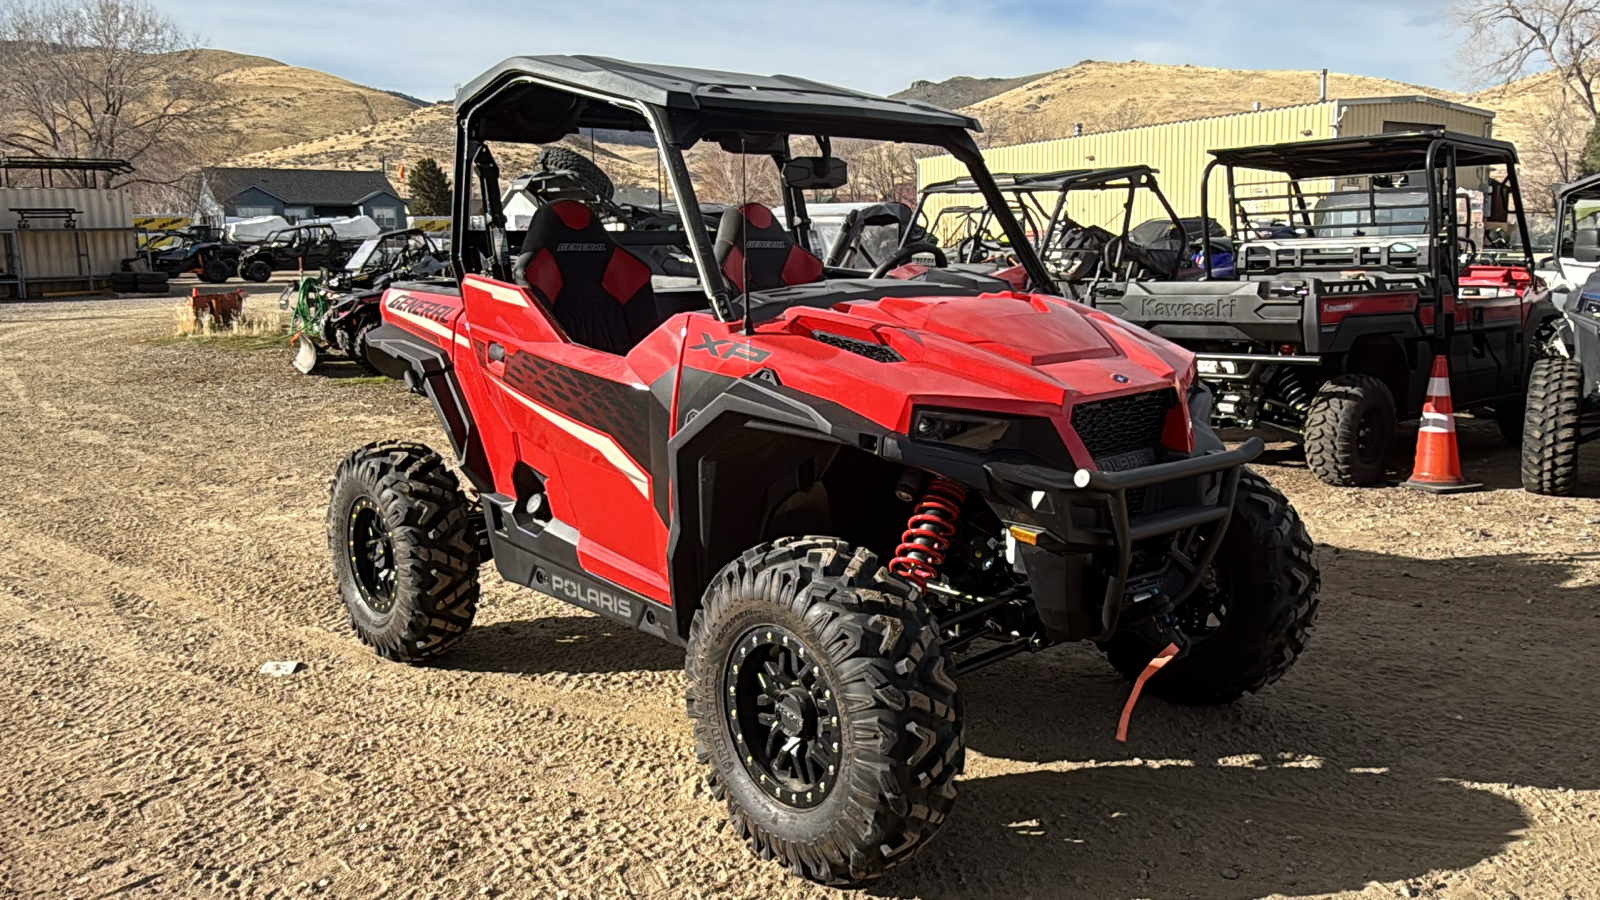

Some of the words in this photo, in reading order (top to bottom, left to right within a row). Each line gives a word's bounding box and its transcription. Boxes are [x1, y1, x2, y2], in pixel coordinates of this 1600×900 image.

[556, 242, 607, 252] GENERAL
[746, 240, 785, 249] GENERAL
[387, 294, 455, 323] GENERAL
[1141, 298, 1236, 318] Kawasaki
[1323, 302, 1353, 313] Kawasaki
[688, 331, 772, 363] XP
[551, 575, 632, 618] POLARIS
